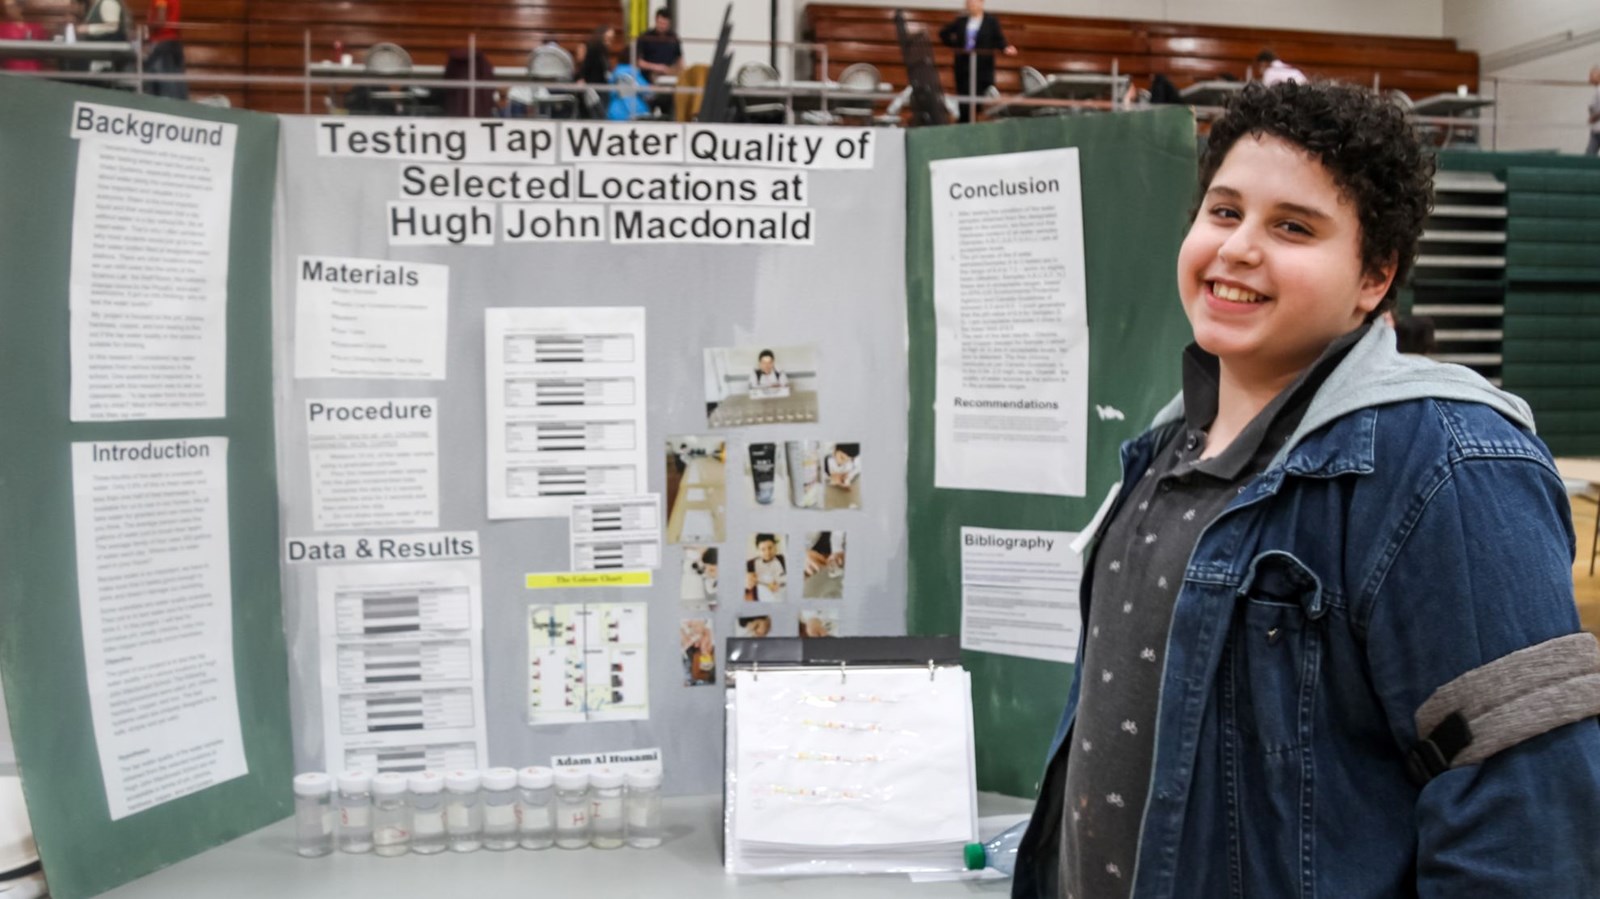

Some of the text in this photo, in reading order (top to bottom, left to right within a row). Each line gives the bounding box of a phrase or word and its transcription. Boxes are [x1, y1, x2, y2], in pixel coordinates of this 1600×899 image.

[76, 106, 223, 146] Background
[320, 122, 871, 165] Testing Tap Water Quality of
[402, 165, 804, 202] Selected Locations at
[949, 176, 1060, 200] Conclusion
[390, 204, 812, 244] Hugh John Macdonald
[302, 260, 419, 286] Materials
[309, 401, 432, 421] Procedure
[954, 397, 1059, 410] Recommendations
[92, 441, 210, 462] Introduction
[288, 536, 474, 561] Data & Results
[964, 534, 1054, 551] Bibliography
[556, 757, 592, 767] Adam
[595, 755, 607, 764] Al
